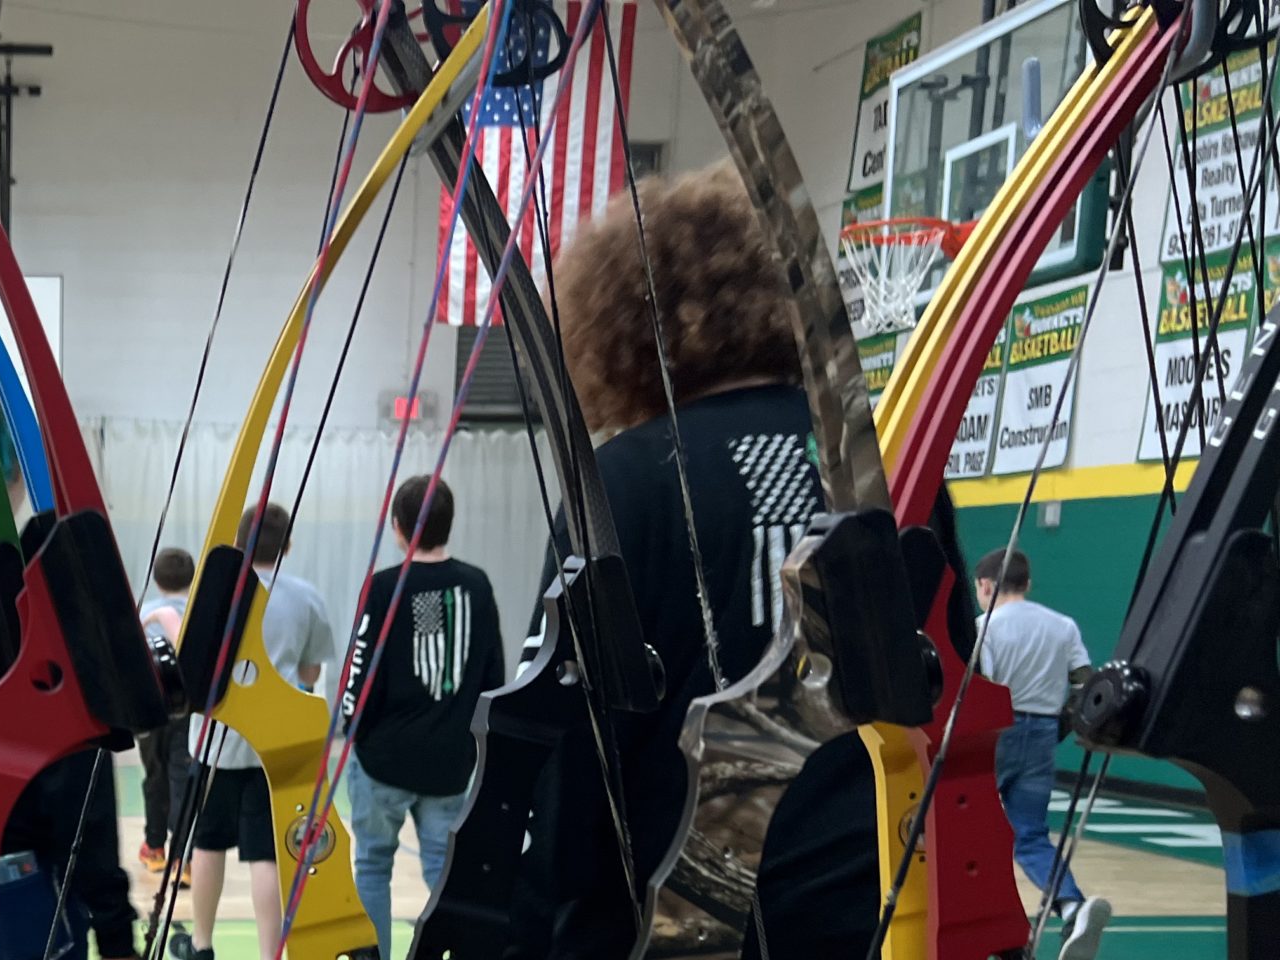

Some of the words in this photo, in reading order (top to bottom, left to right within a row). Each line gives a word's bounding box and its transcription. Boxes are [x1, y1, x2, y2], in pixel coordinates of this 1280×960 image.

[1200, 161, 1238, 190] Realty
[1210, 194, 1249, 219] Turne
[1010, 325, 1081, 365] BASKETBALL
[1026, 384, 1053, 411] SMB
[1154, 396, 1222, 434] MASONR
